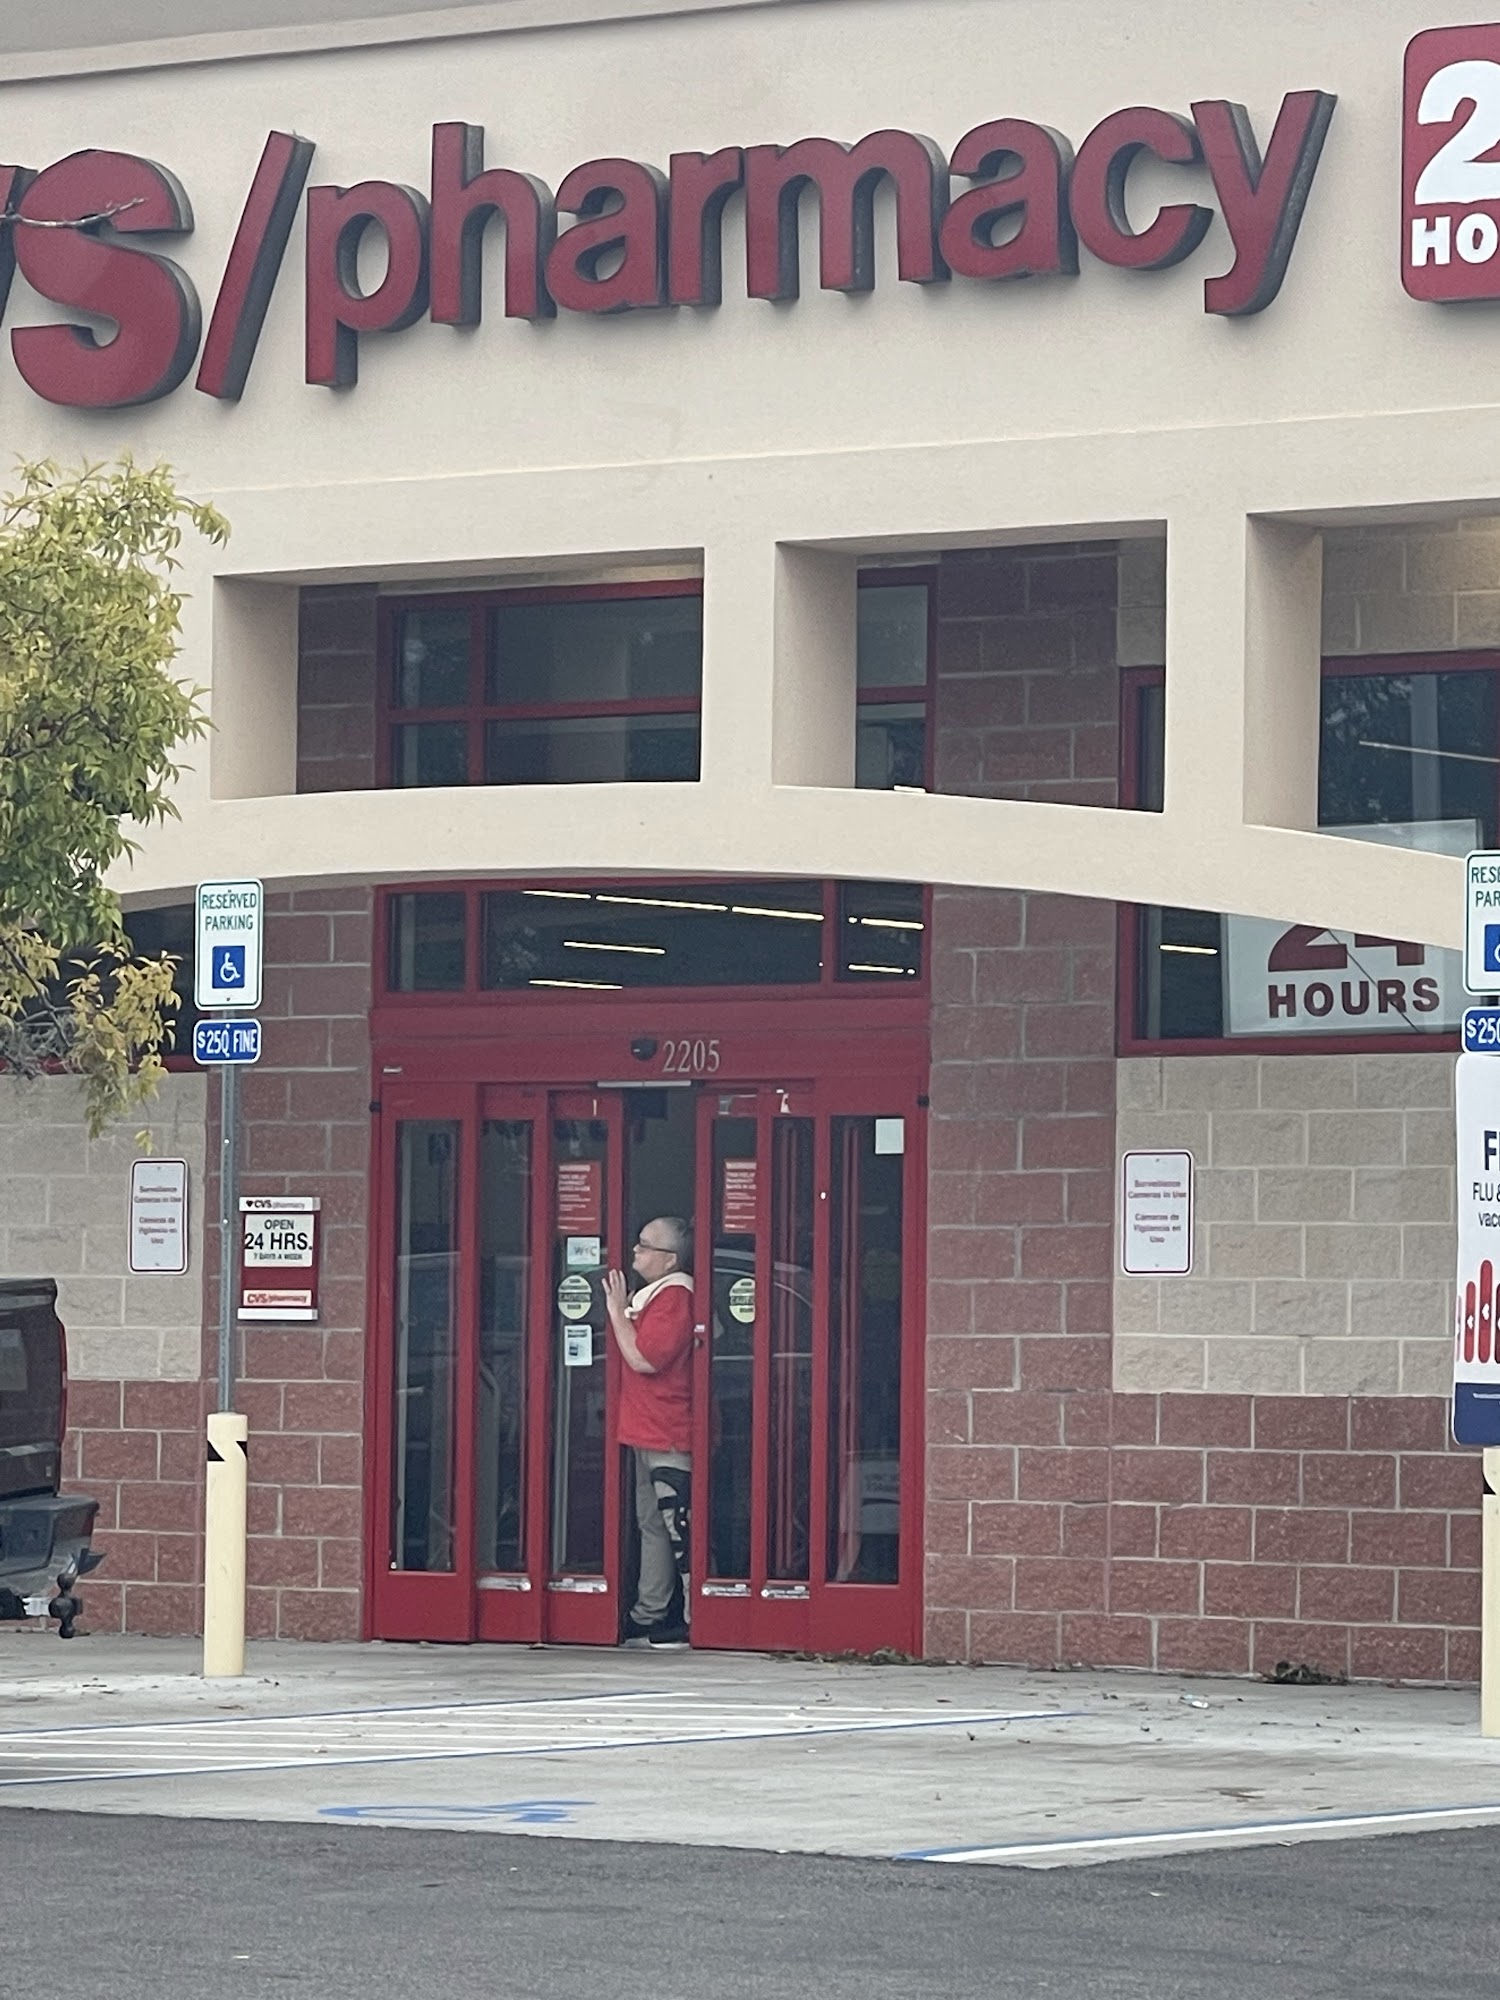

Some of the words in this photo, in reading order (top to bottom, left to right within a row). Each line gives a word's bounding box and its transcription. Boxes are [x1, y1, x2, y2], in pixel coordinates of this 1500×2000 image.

[202, 893, 257, 910] RESERVED
[205, 915, 254, 931] PARKING
[1268, 977, 1440, 1018] HOURS
[197, 1029, 230, 1055] $250
[233, 1029, 257, 1053] FINE
[662, 1039, 720, 1072] 2205
[1473, 1182, 1494, 1202] FLU
[254, 1200, 272, 1209] CVS
[264, 1219, 295, 1230] OPEN
[1478, 1212, 1500, 1228] vac
[244, 1232, 264, 1250] 24
[270, 1232, 313, 1250] HRS.
